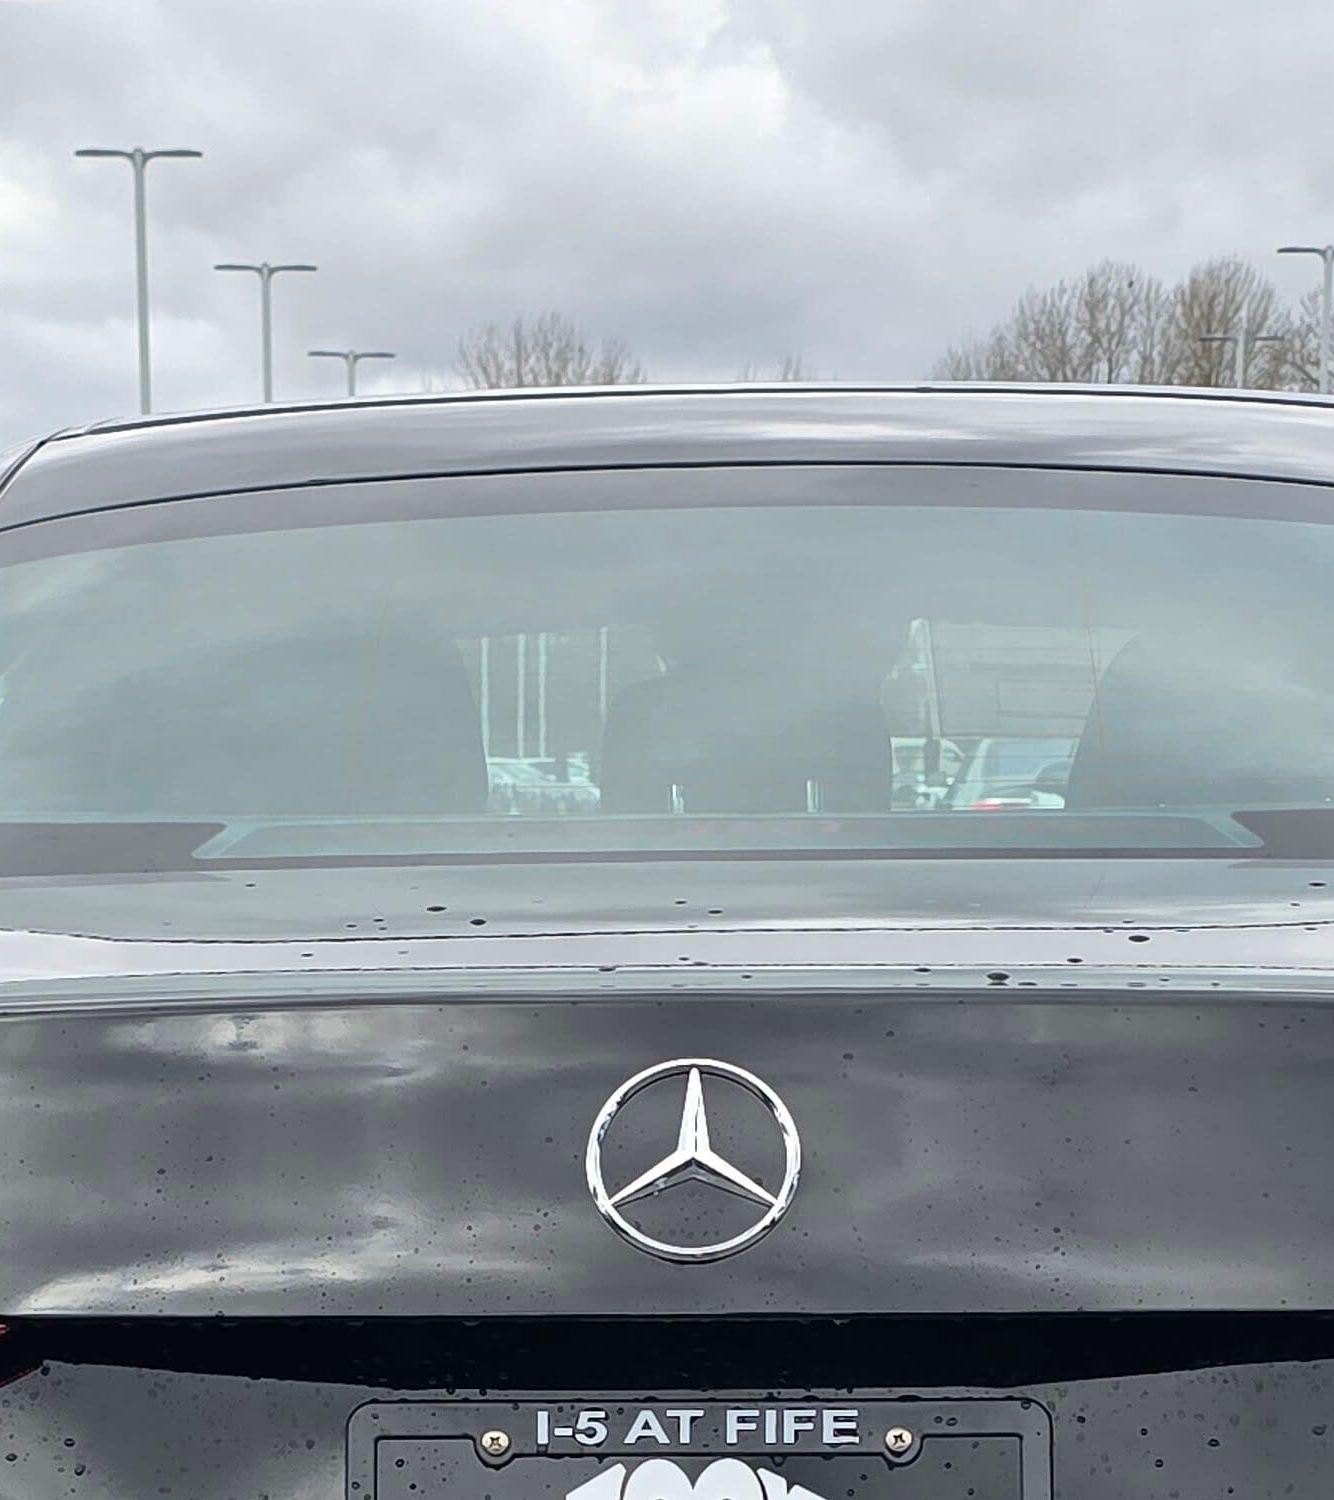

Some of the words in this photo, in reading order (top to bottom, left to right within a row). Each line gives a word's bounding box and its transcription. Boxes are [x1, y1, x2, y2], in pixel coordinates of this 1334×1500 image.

[536, 1409, 607, 1445] I-5
[623, 1409, 704, 1444] AT
[725, 1409, 860, 1444] FIFE
